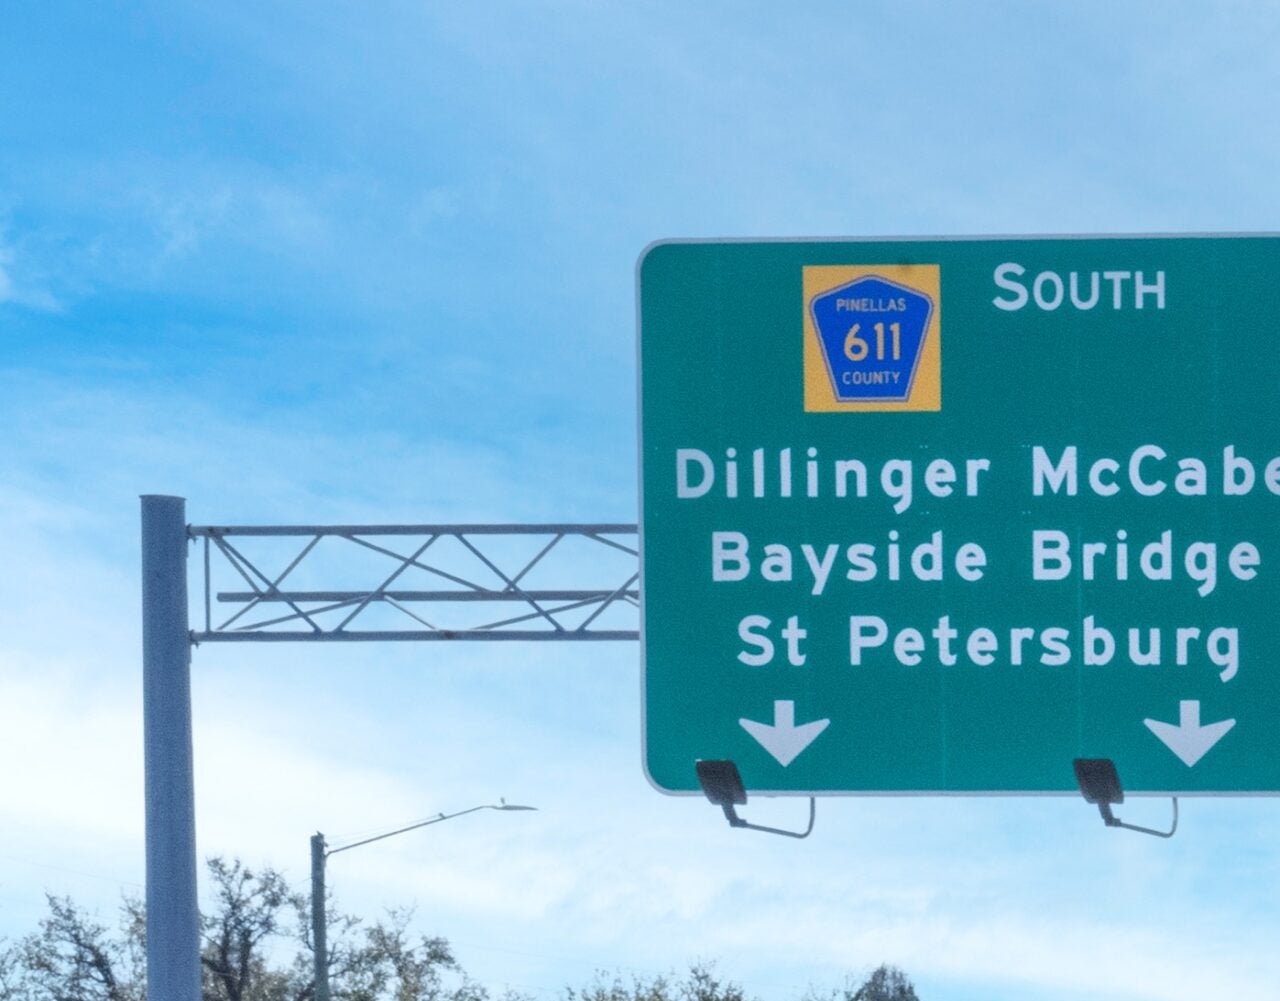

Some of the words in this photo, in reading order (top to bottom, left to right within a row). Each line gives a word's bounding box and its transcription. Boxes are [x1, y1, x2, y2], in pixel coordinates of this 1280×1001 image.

[835, 297, 906, 313] PINELLAS
[992, 262, 1166, 311] SOUTH
[843, 322, 900, 362] 611
[842, 370, 900, 385] COUNTY
[676, 447, 991, 515] Dillinger
[712, 530, 987, 596] Bayside
[1032, 529, 1261, 597] Bridge
[737, 614, 807, 667] St
[849, 615, 1239, 683] Petersburg
